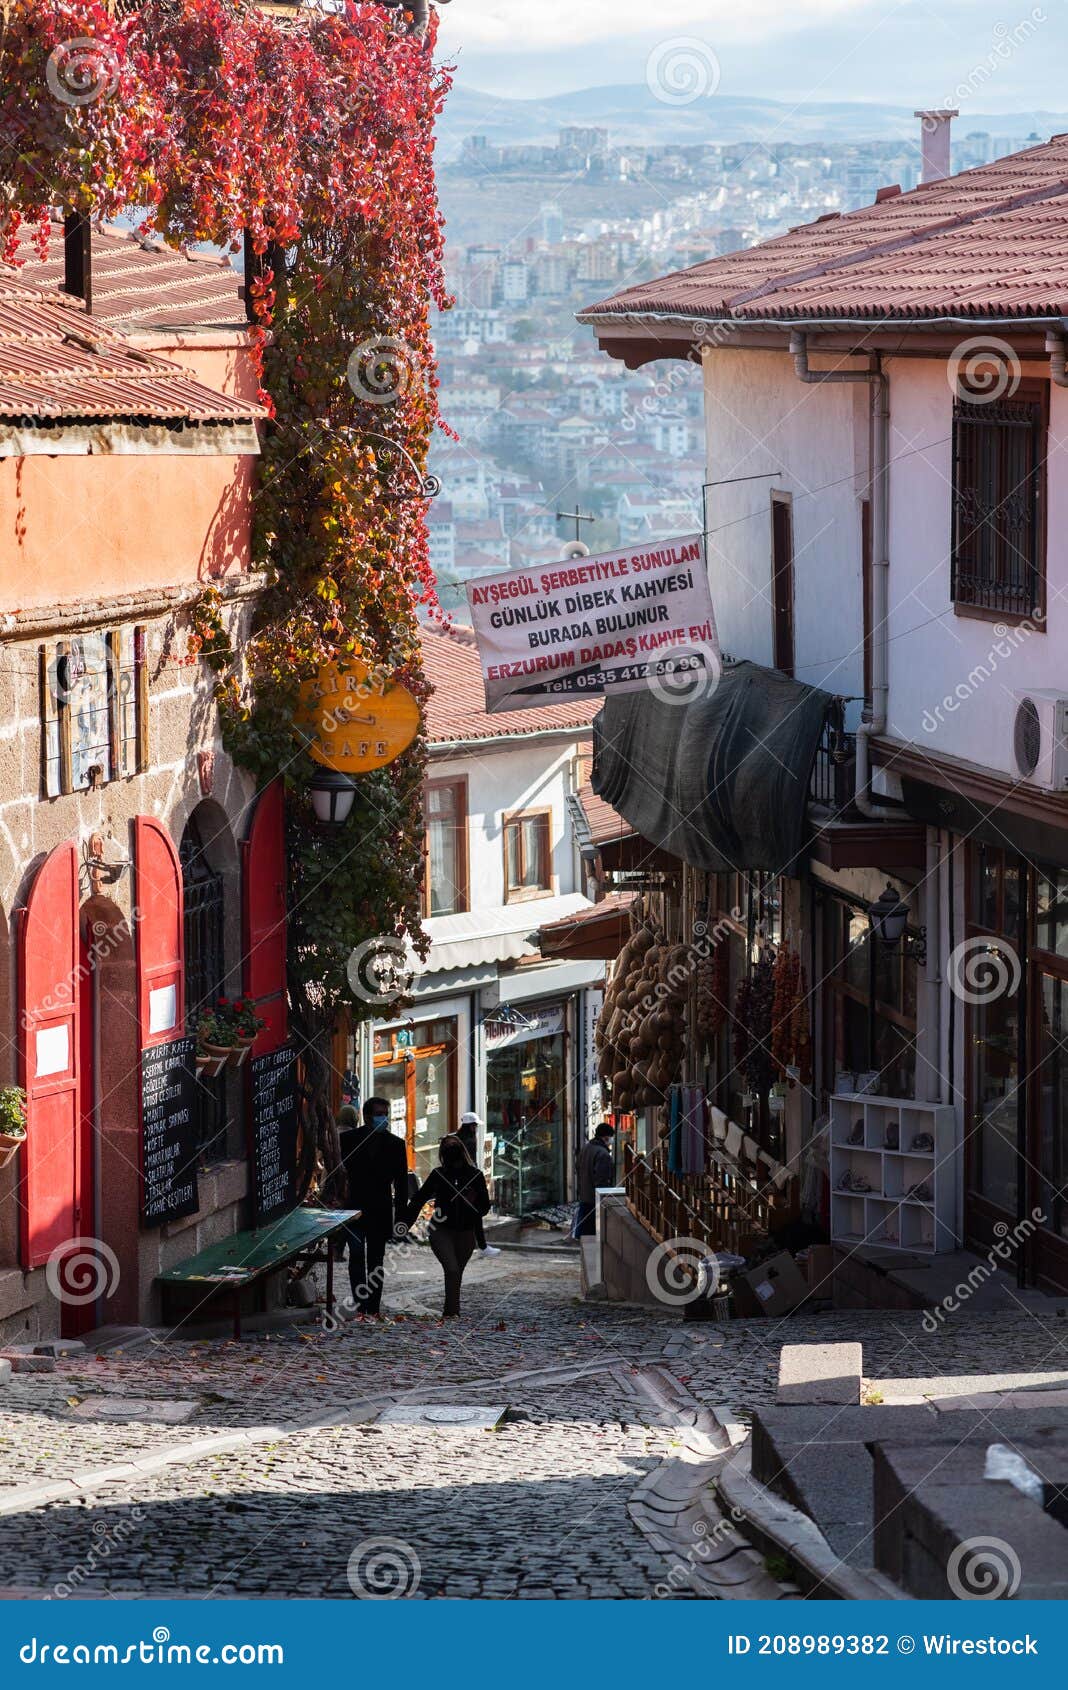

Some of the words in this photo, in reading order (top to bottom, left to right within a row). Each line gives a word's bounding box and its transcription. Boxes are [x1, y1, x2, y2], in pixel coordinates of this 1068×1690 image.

[472, 575, 539, 606] AYŞEGÜL
[540, 558, 629, 594] ŞERBETİYLE
[632, 543, 701, 573] SUNULAN
[490, 599, 562, 629] GÜNLÜK
[566, 588, 616, 614] DİBEK
[621, 568, 694, 602] KAHVESİ
[487, 650, 576, 681] ERZURUM
[580, 637, 637, 664] DADAŞ
[639, 628, 686, 652] KAHVE
[688, 620, 713, 643] EVİ
[528, 621, 593, 649] BURADA
[596, 604, 669, 635] BULUNUR
[543, 675, 572, 693] Tel:
[576, 669, 616, 688] 0535
[621, 664, 651, 680] 412
[655, 660, 675, 674] 30
[680, 656, 700, 671] 96
[322, 741, 389, 758] CAFE
